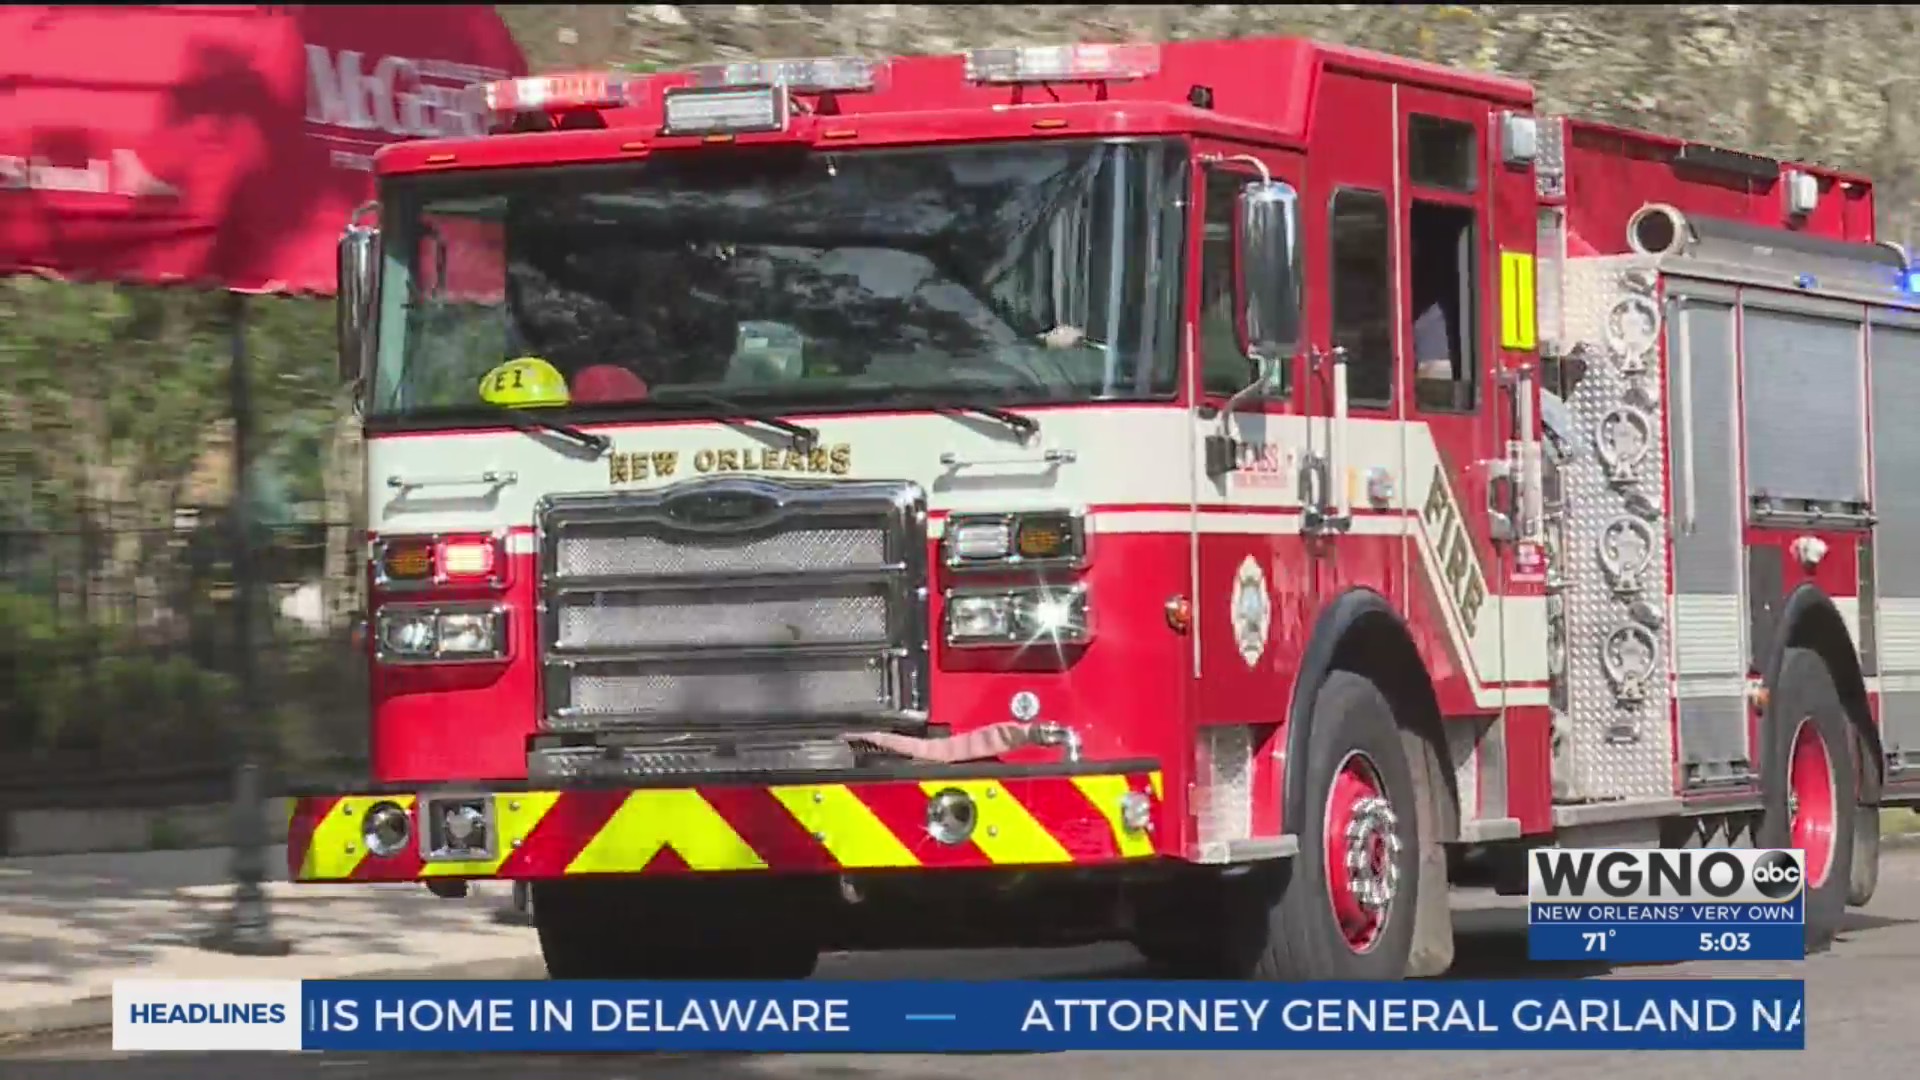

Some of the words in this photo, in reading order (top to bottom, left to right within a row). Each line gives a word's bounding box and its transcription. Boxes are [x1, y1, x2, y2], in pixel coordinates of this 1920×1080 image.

[609, 450, 679, 484] NEW
[694, 443, 851, 474] ORLEANS
[1424, 464, 1484, 638] FIRE
